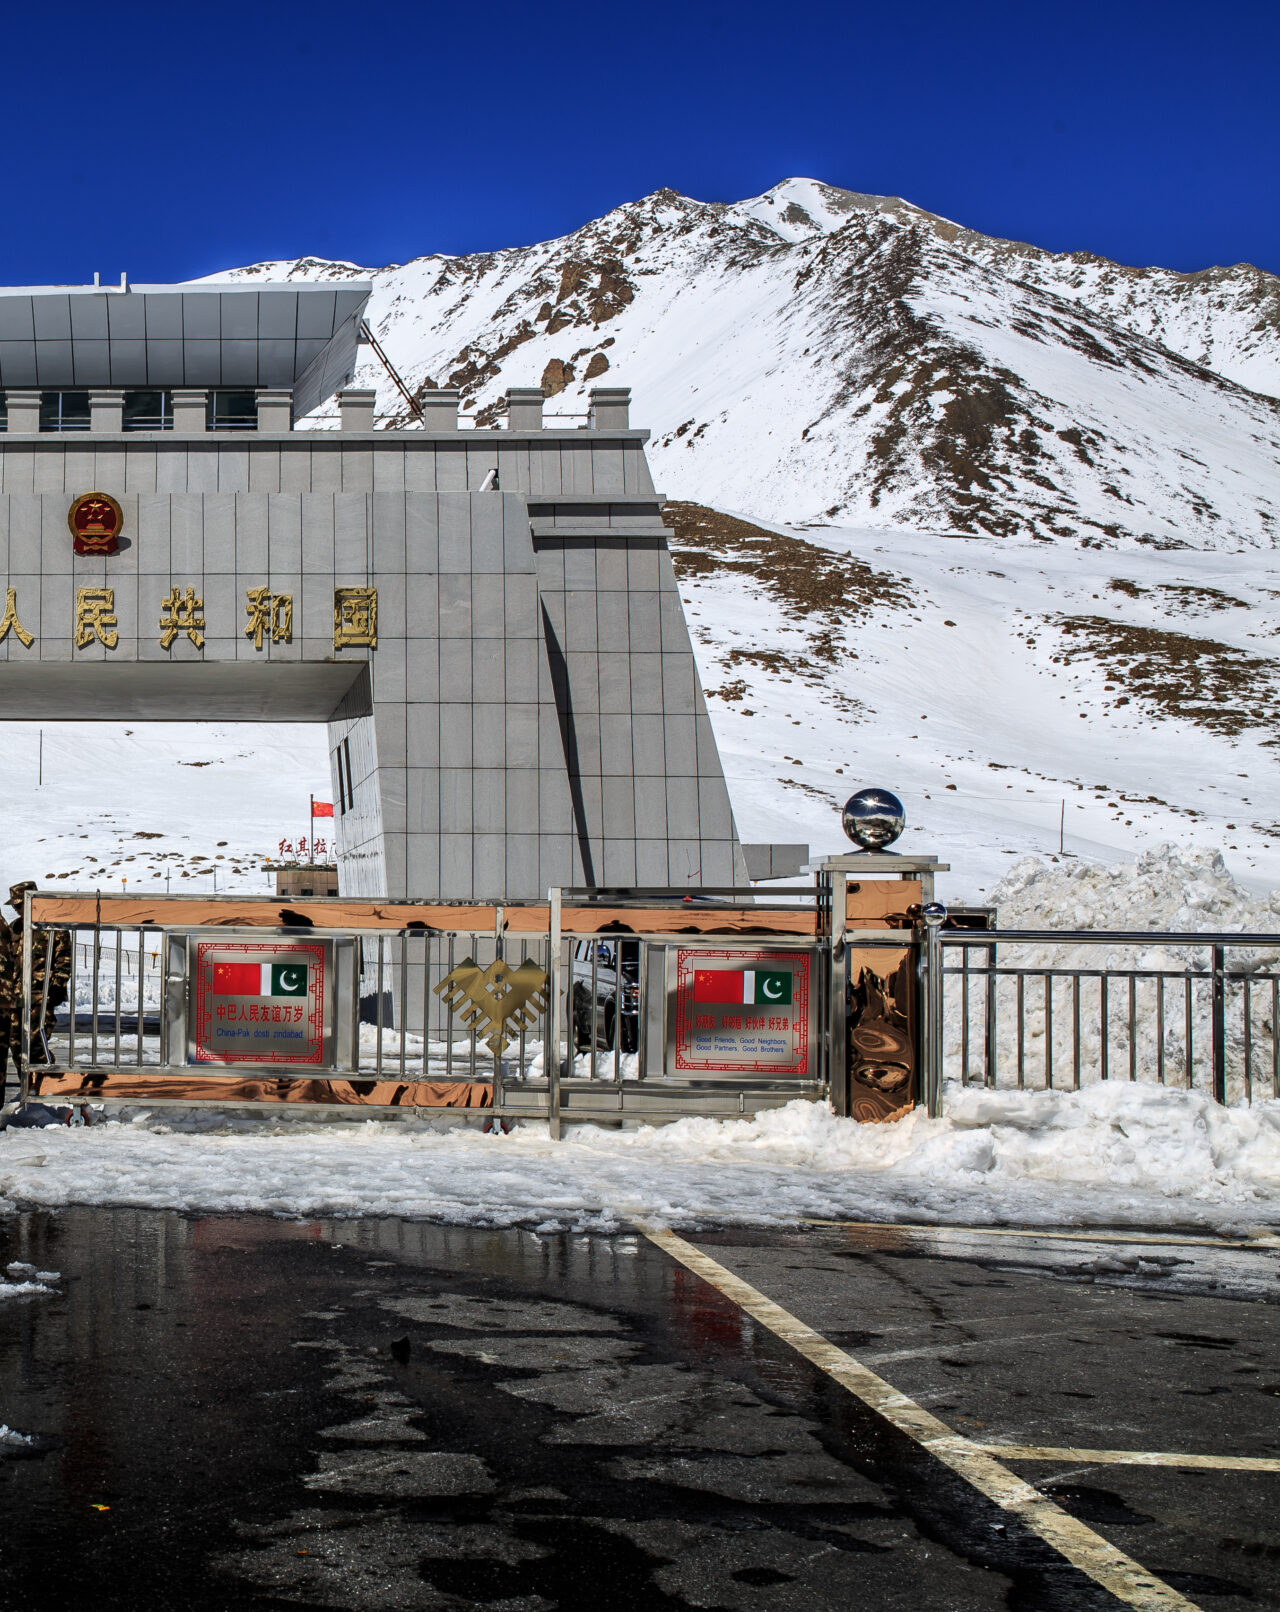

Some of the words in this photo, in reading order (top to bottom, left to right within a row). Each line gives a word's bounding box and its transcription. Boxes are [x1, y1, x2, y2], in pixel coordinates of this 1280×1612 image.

[278, 836, 337, 856] 红其拉
[216, 1004, 303, 1023] 中巴人民友谊万岁
[768, 1017, 789, 1031] 好兄弟
[216, 1028, 250, 1038] China-Pak
[254, 1029, 269, 1038] dosti
[273, 1030, 303, 1039] zindabad
